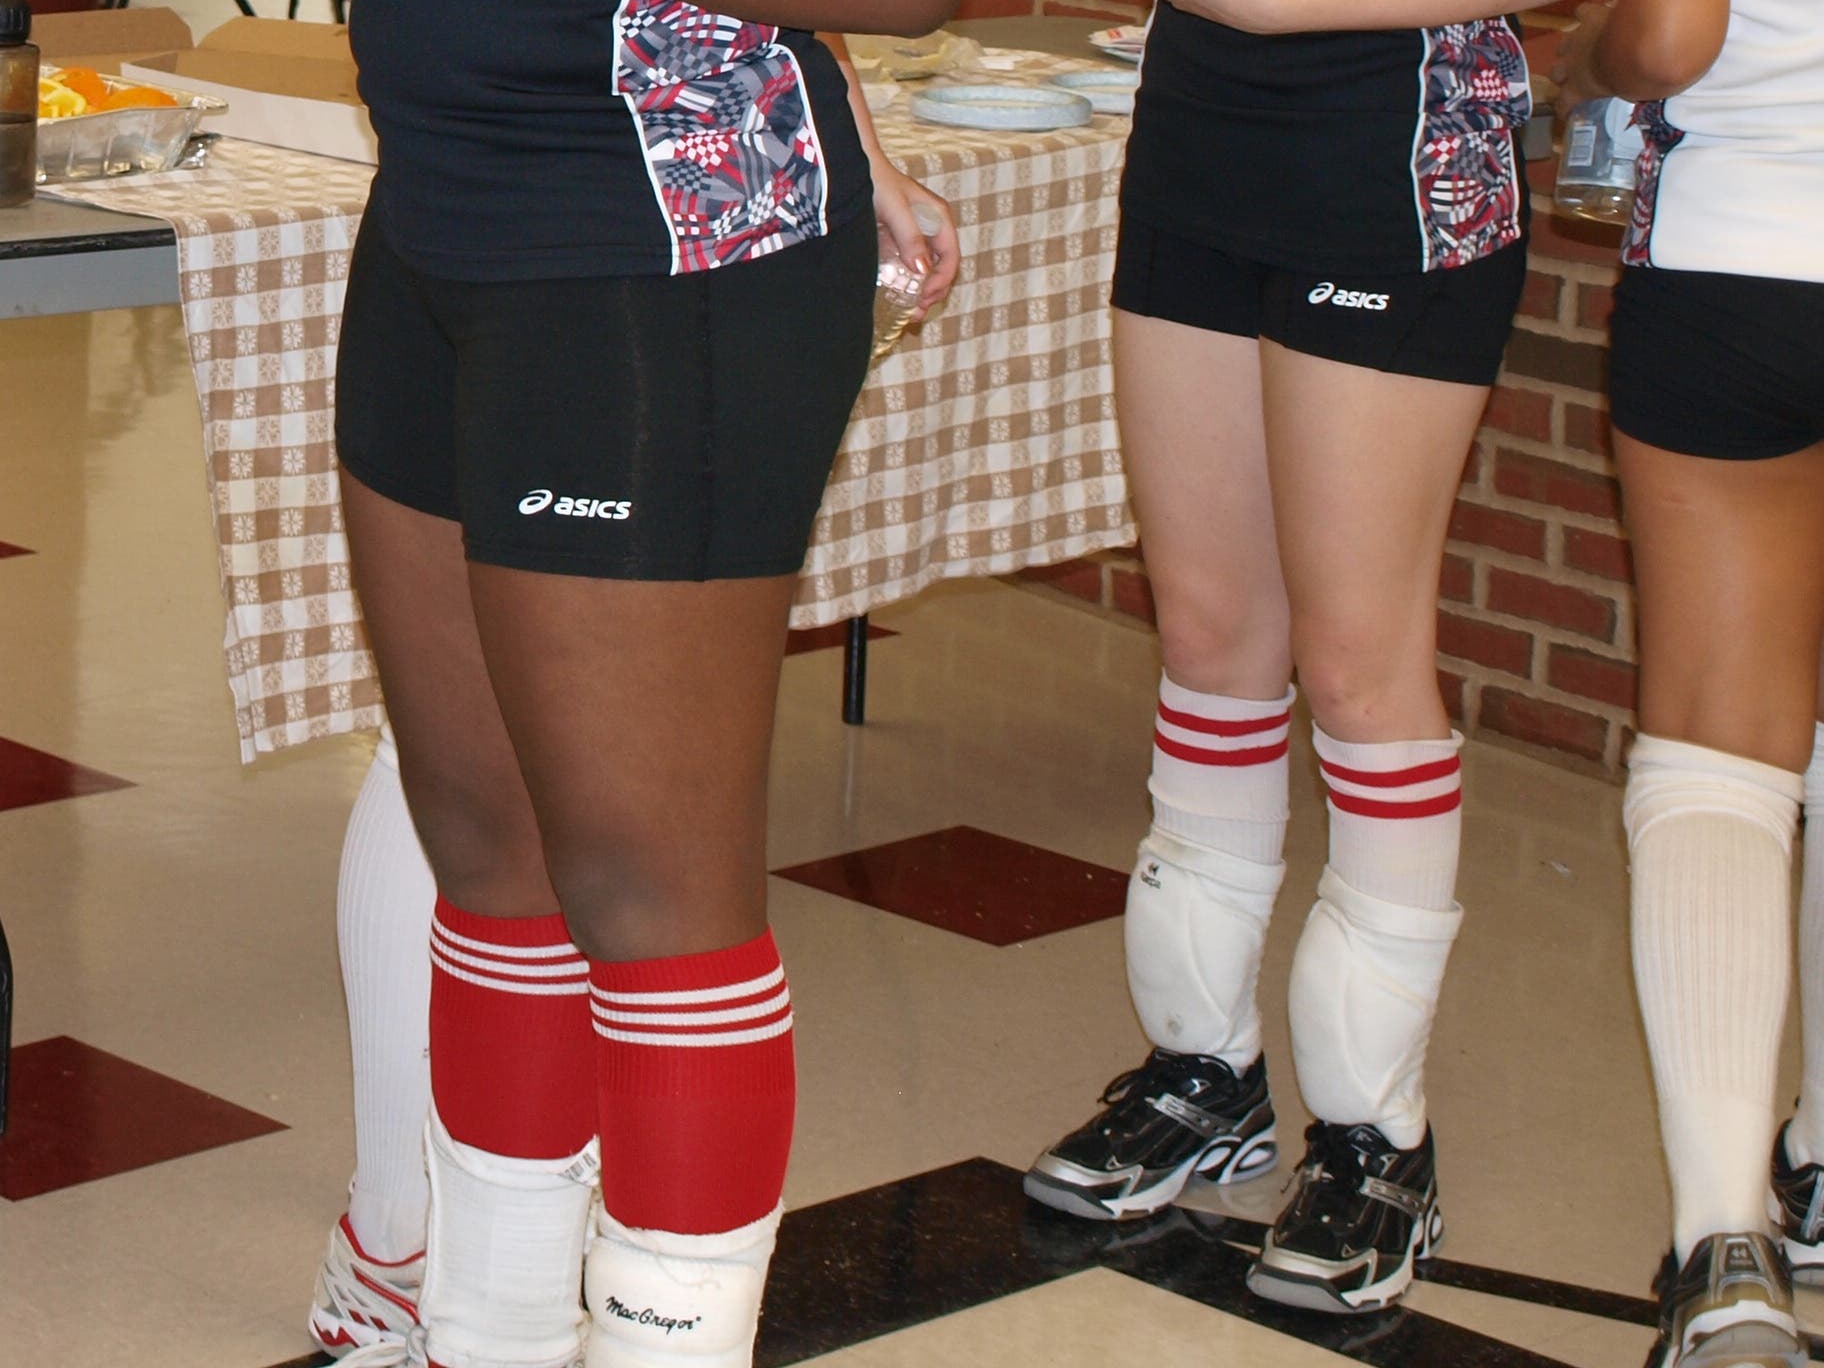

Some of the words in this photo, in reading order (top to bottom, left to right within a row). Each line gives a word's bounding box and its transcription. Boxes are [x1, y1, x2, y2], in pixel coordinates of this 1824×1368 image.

[1331, 289, 1390, 311] asics
[553, 496, 632, 520] asics
[606, 1295, 696, 1335] MacGregor
